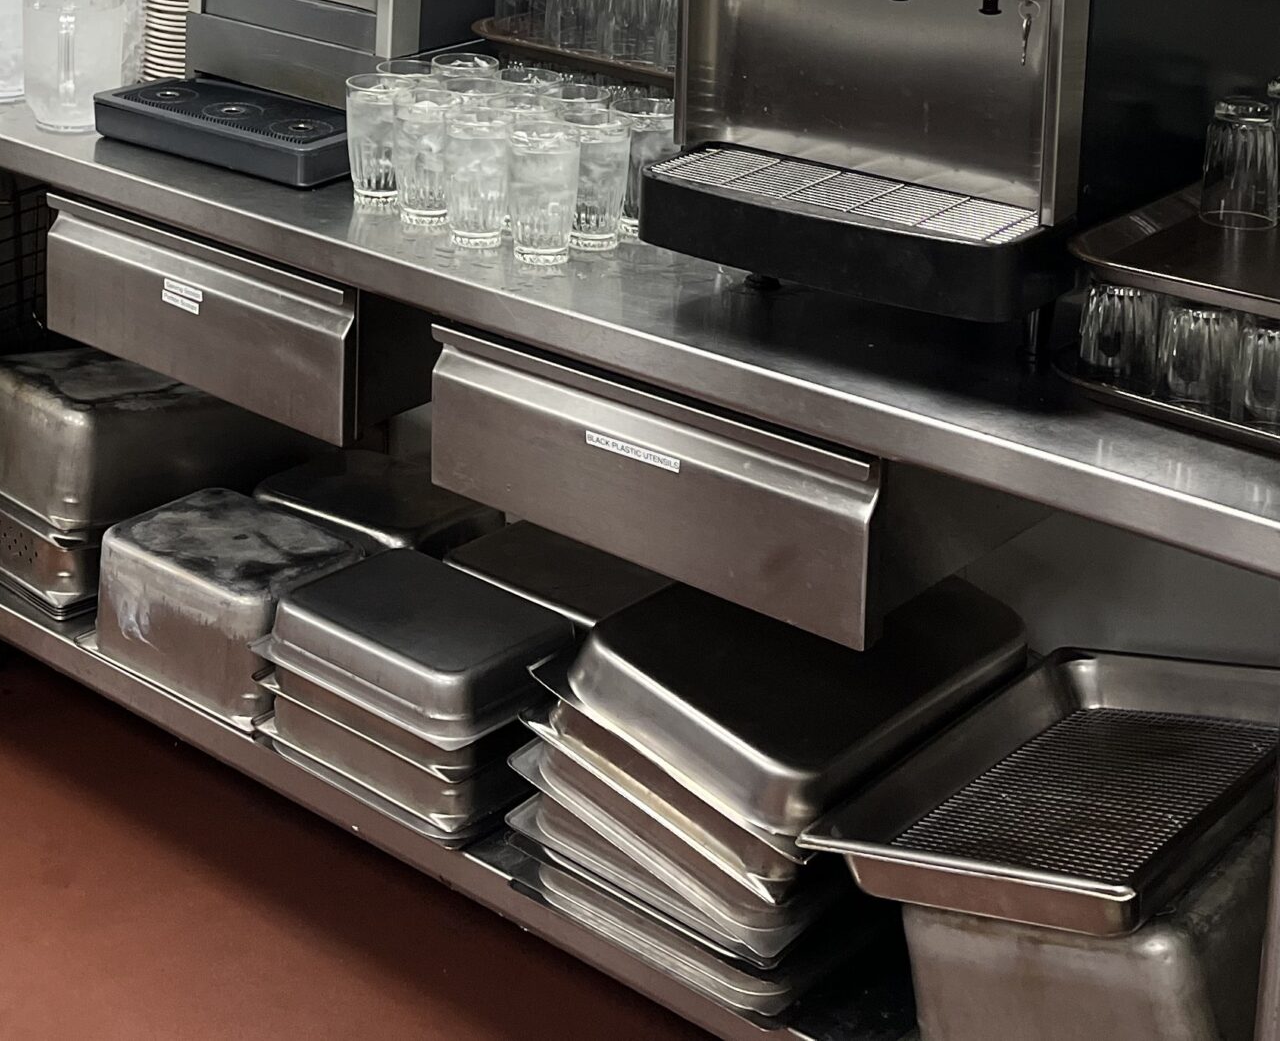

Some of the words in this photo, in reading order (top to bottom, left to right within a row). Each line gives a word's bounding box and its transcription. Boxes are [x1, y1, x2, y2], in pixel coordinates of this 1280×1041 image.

[586, 433, 610, 448] BLACK
[612, 441, 642, 458] PLASTIC
[643, 451, 680, 470] UTENSILS
